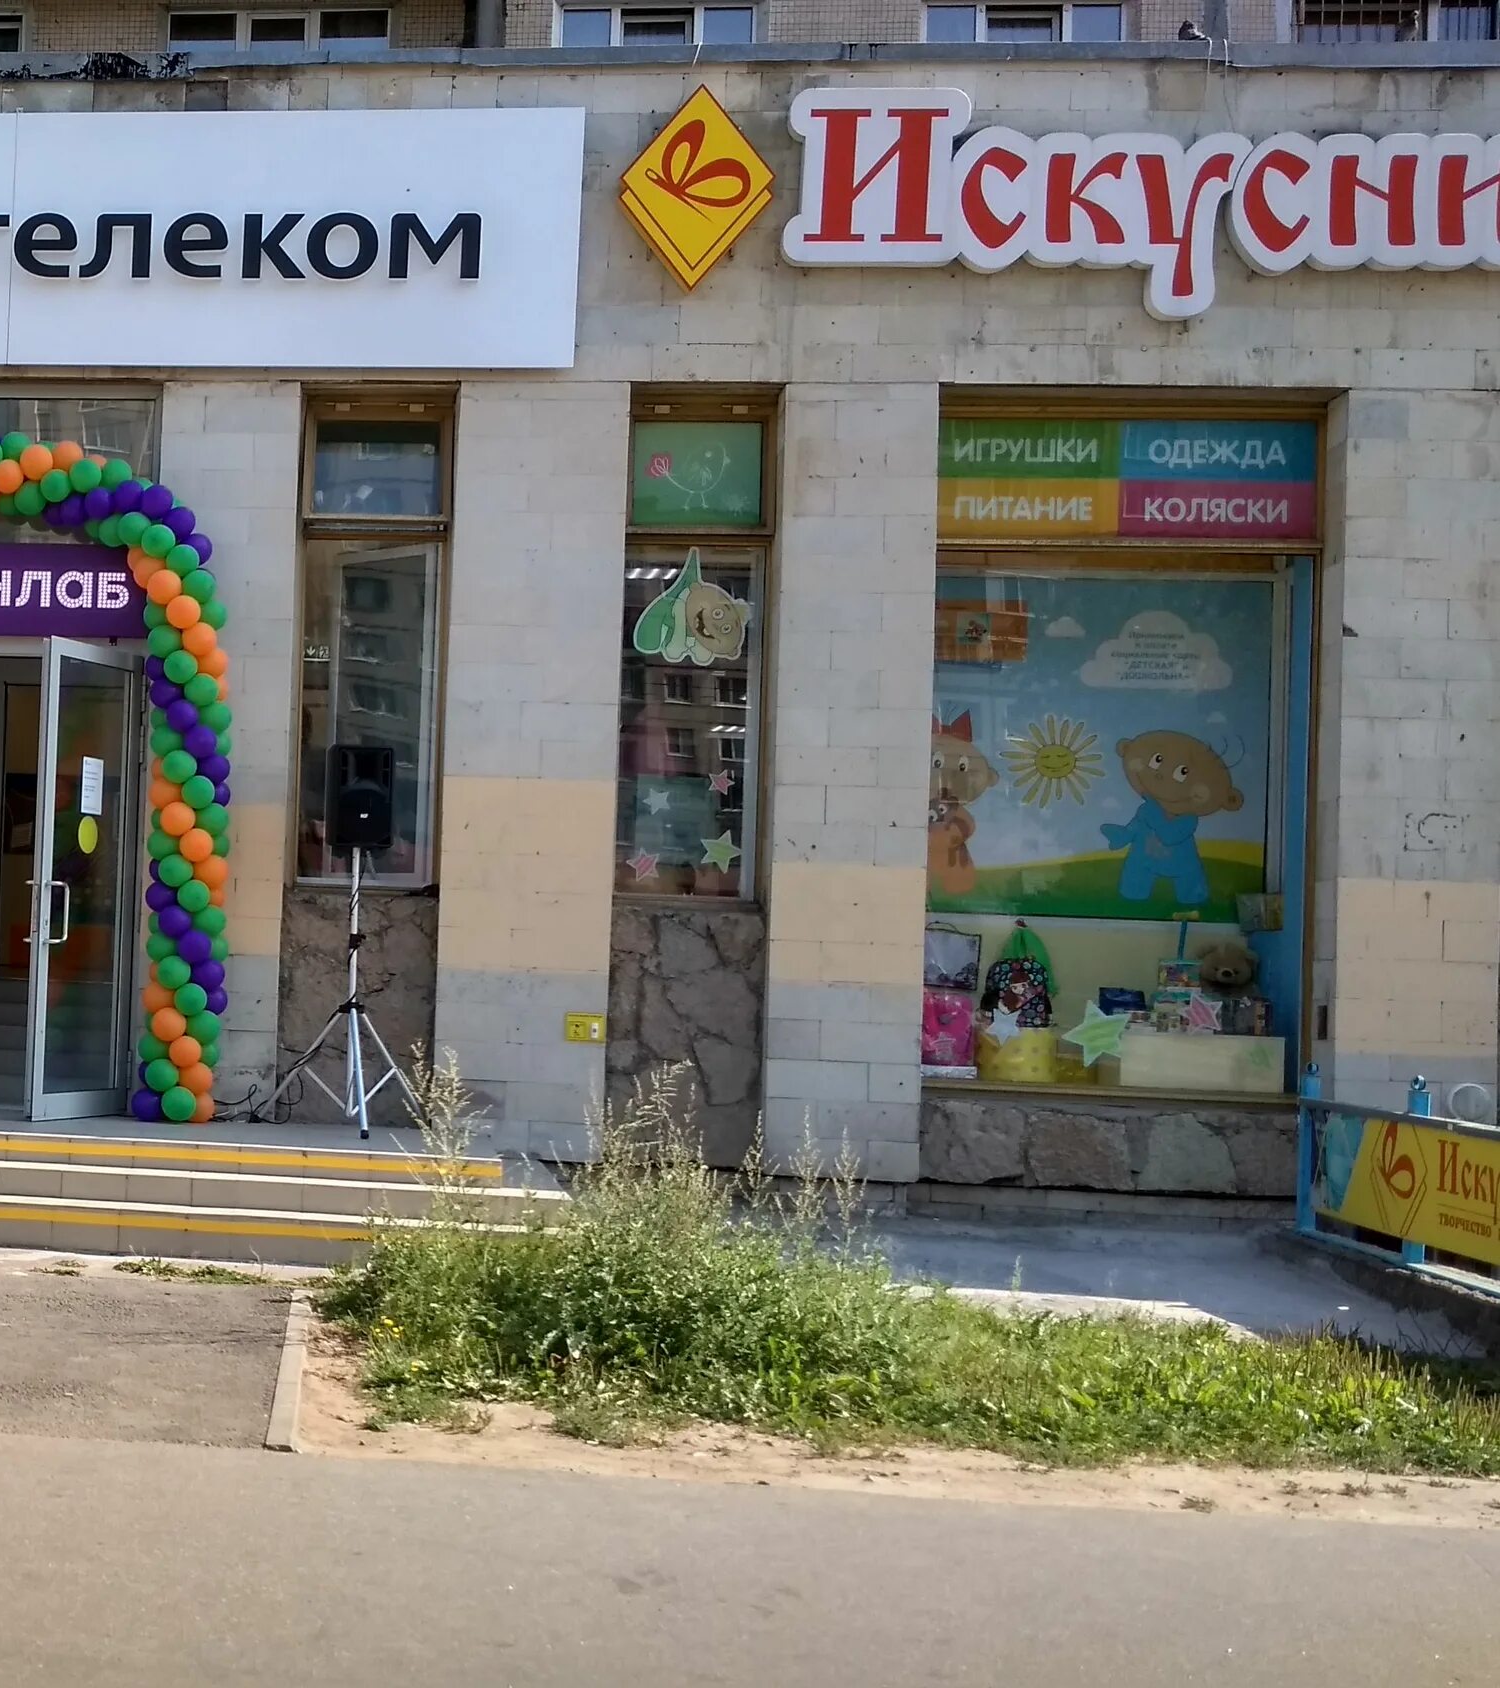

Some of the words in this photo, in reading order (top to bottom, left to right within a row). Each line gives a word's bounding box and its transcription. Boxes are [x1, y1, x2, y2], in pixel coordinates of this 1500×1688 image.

[953, 437, 1098, 464] ИГРУШКИ
[1148, 439, 1287, 470] ОДЕЖДА
[953, 495, 1093, 522] ПИТАНИЕ
[1143, 497, 1289, 525] КОЛЯСКИ
[1438, 1212, 1492, 1238] ТВОРЧЕСТВО
